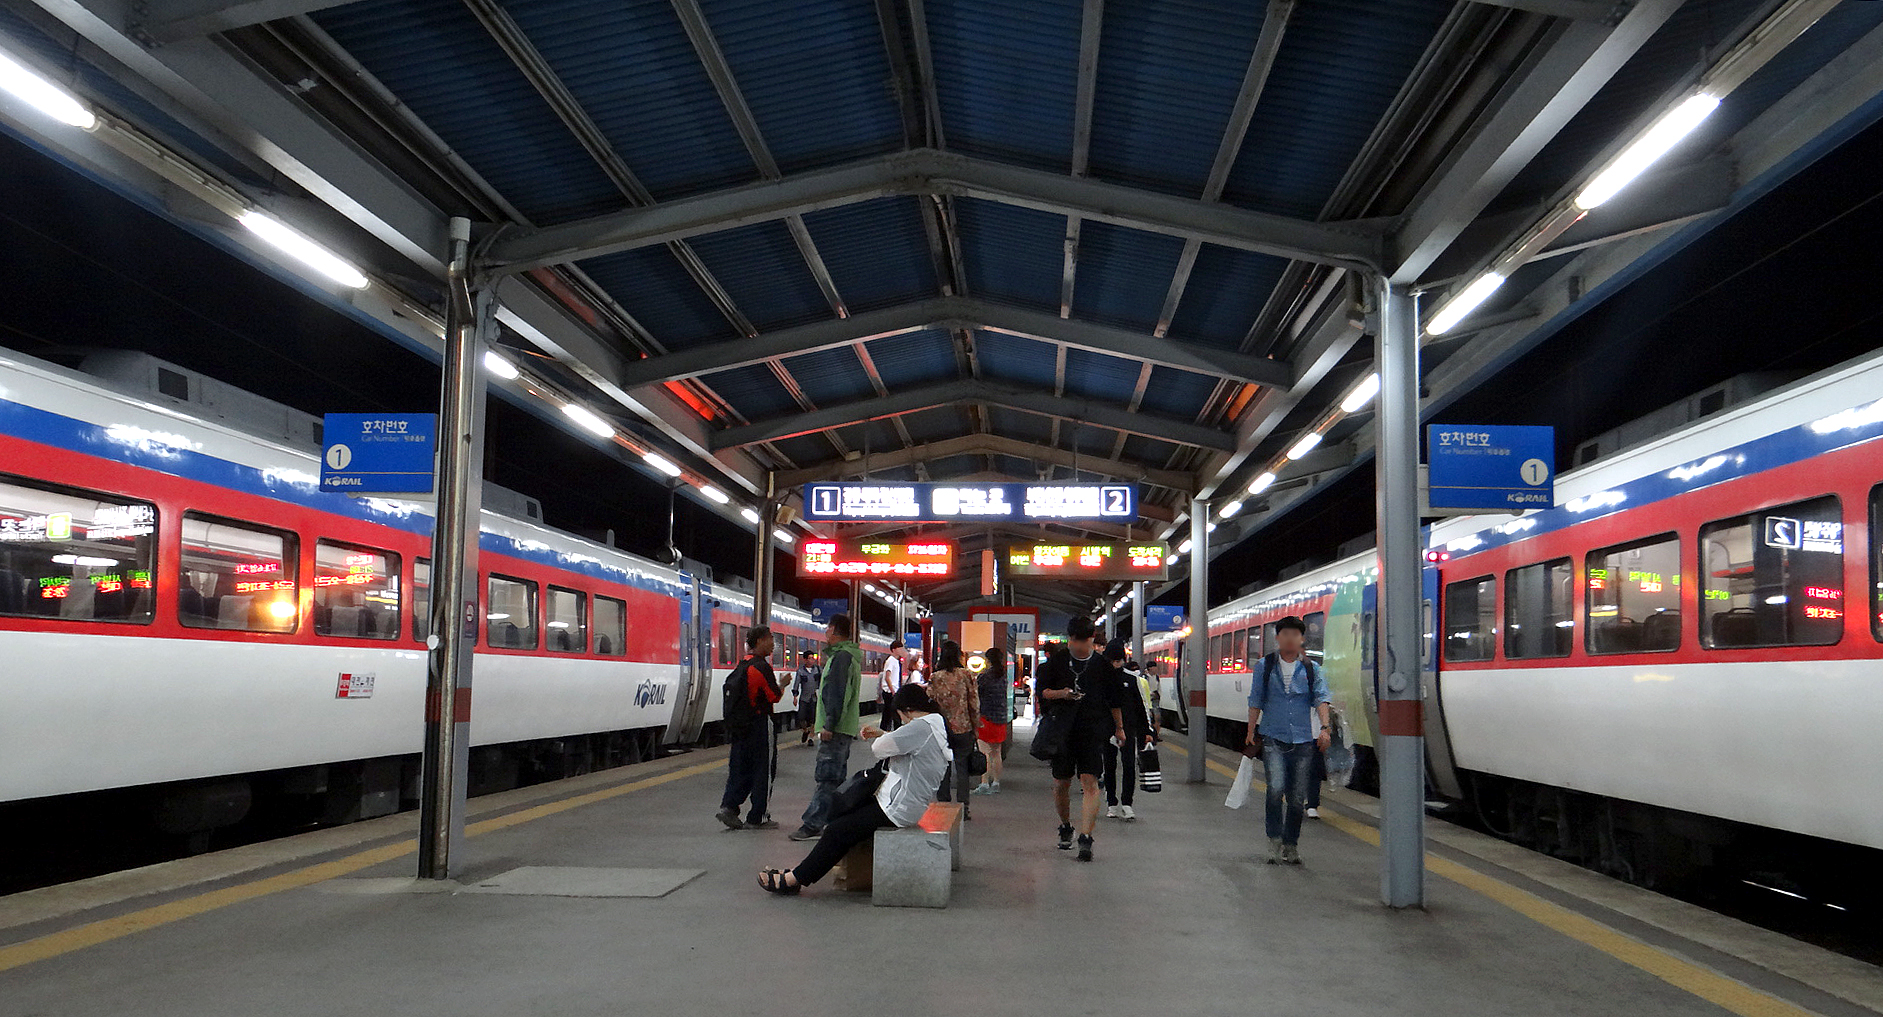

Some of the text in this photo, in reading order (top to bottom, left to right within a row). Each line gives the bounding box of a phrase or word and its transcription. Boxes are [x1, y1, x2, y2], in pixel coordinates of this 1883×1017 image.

[361, 420, 409, 434] 호차번호
[1439, 431, 1490, 447] 호차번호
[335, 448, 342, 466] 1
[1529, 463, 1537, 482] 1
[324, 476, 363, 486] KORAIL
[820, 491, 831, 511] 1
[1107, 490, 1124, 512] 2
[1507, 492, 1549, 503] KORAIL
[861, 544, 891, 554] 무궁화
[1010, 555, 1030, 565] 이번
[633, 678, 668, 709] KORAIL
